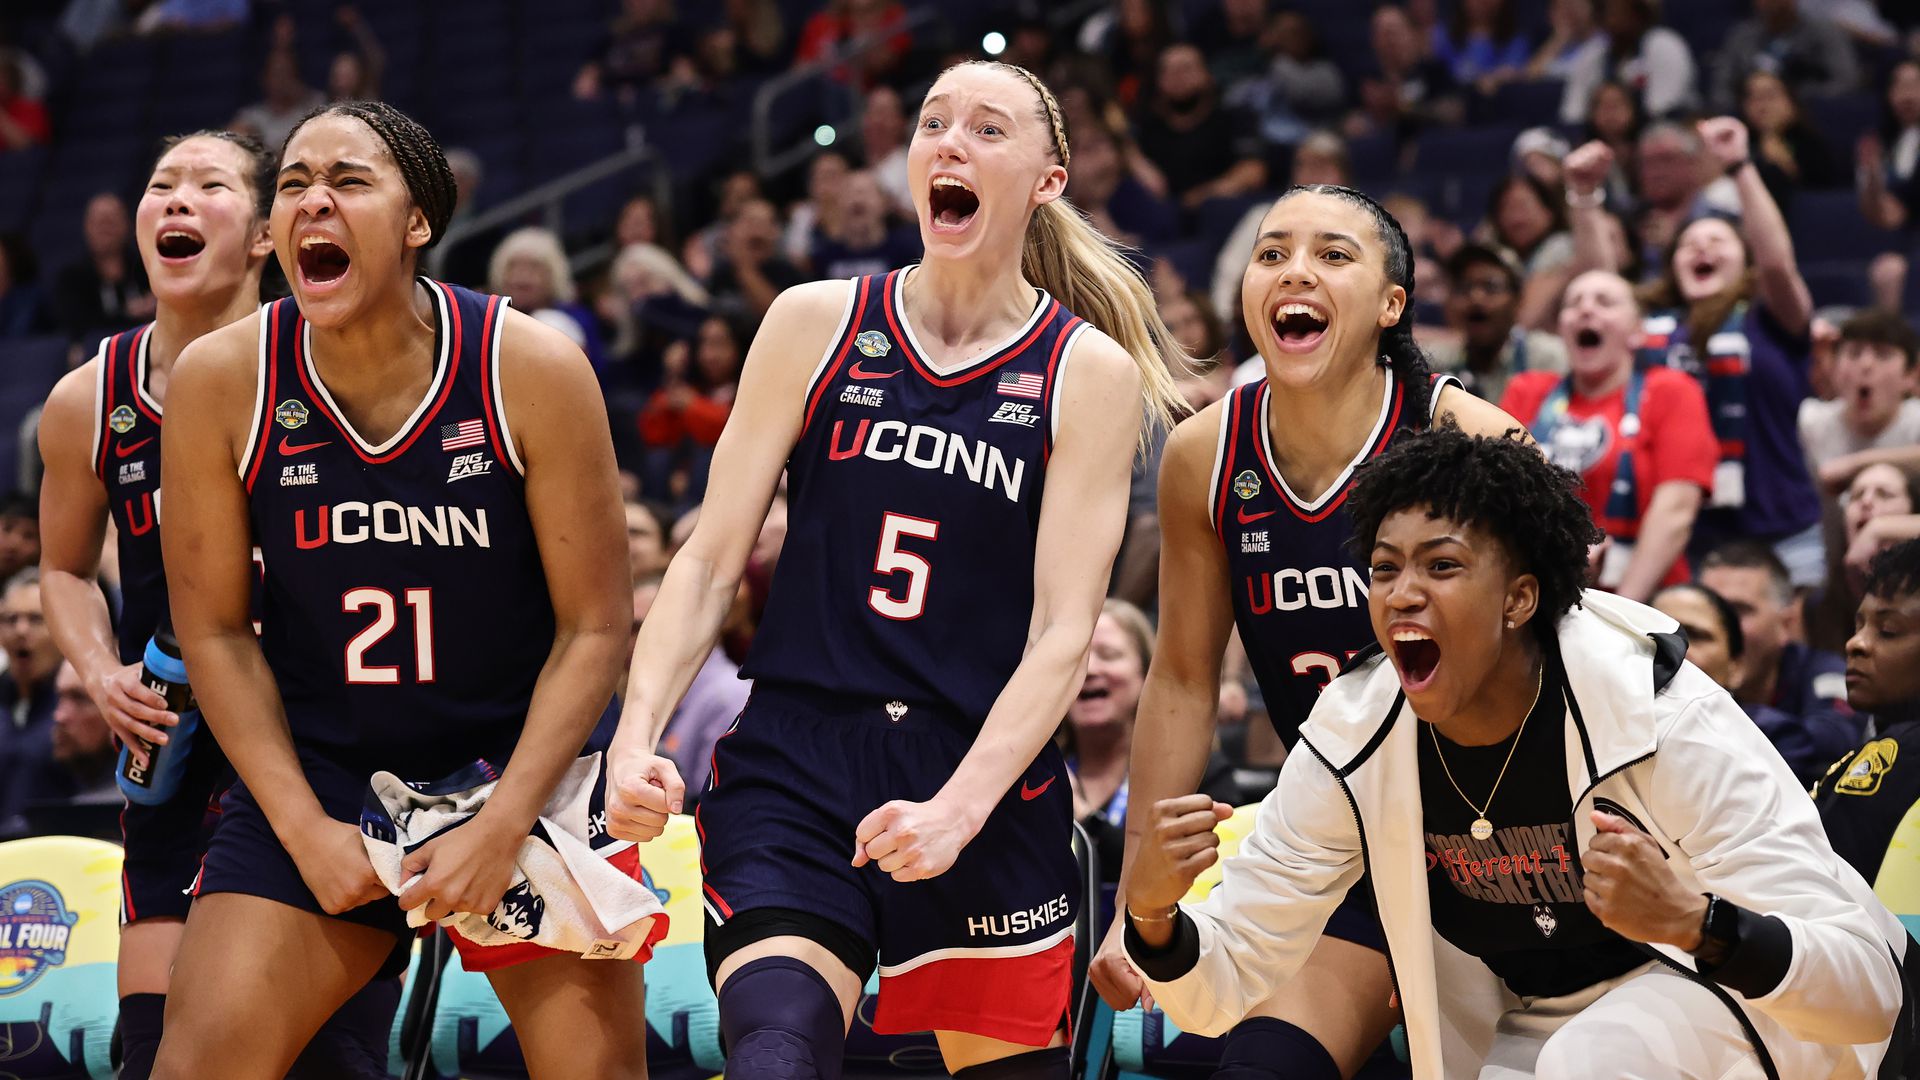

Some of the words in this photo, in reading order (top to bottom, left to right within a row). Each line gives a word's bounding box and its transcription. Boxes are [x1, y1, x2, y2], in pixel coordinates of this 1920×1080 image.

[845, 384, 862, 394] BE
[863, 387, 884, 397] THE
[840, 392, 884, 408] CHANGE
[998, 401, 1035, 415] BIG
[991, 409, 1041, 424] EAST
[452, 452, 484, 468] BIG
[828, 418, 1025, 503] UCONN
[282, 465, 296, 477] BE
[297, 463, 316, 475] THE
[448, 460, 494, 478] EAST
[279, 473, 319, 487] CHANGE
[294, 500, 491, 550] UCONN
[1241, 532, 1250, 543] BE
[1250, 531, 1269, 543] THE
[1241, 541, 1271, 553] CHANGE
[867, 510, 940, 621] 5
[341, 586, 437, 685] 21
[967, 893, 1070, 936] HUSKIES
[16, 923, 69, 951] FOUR
